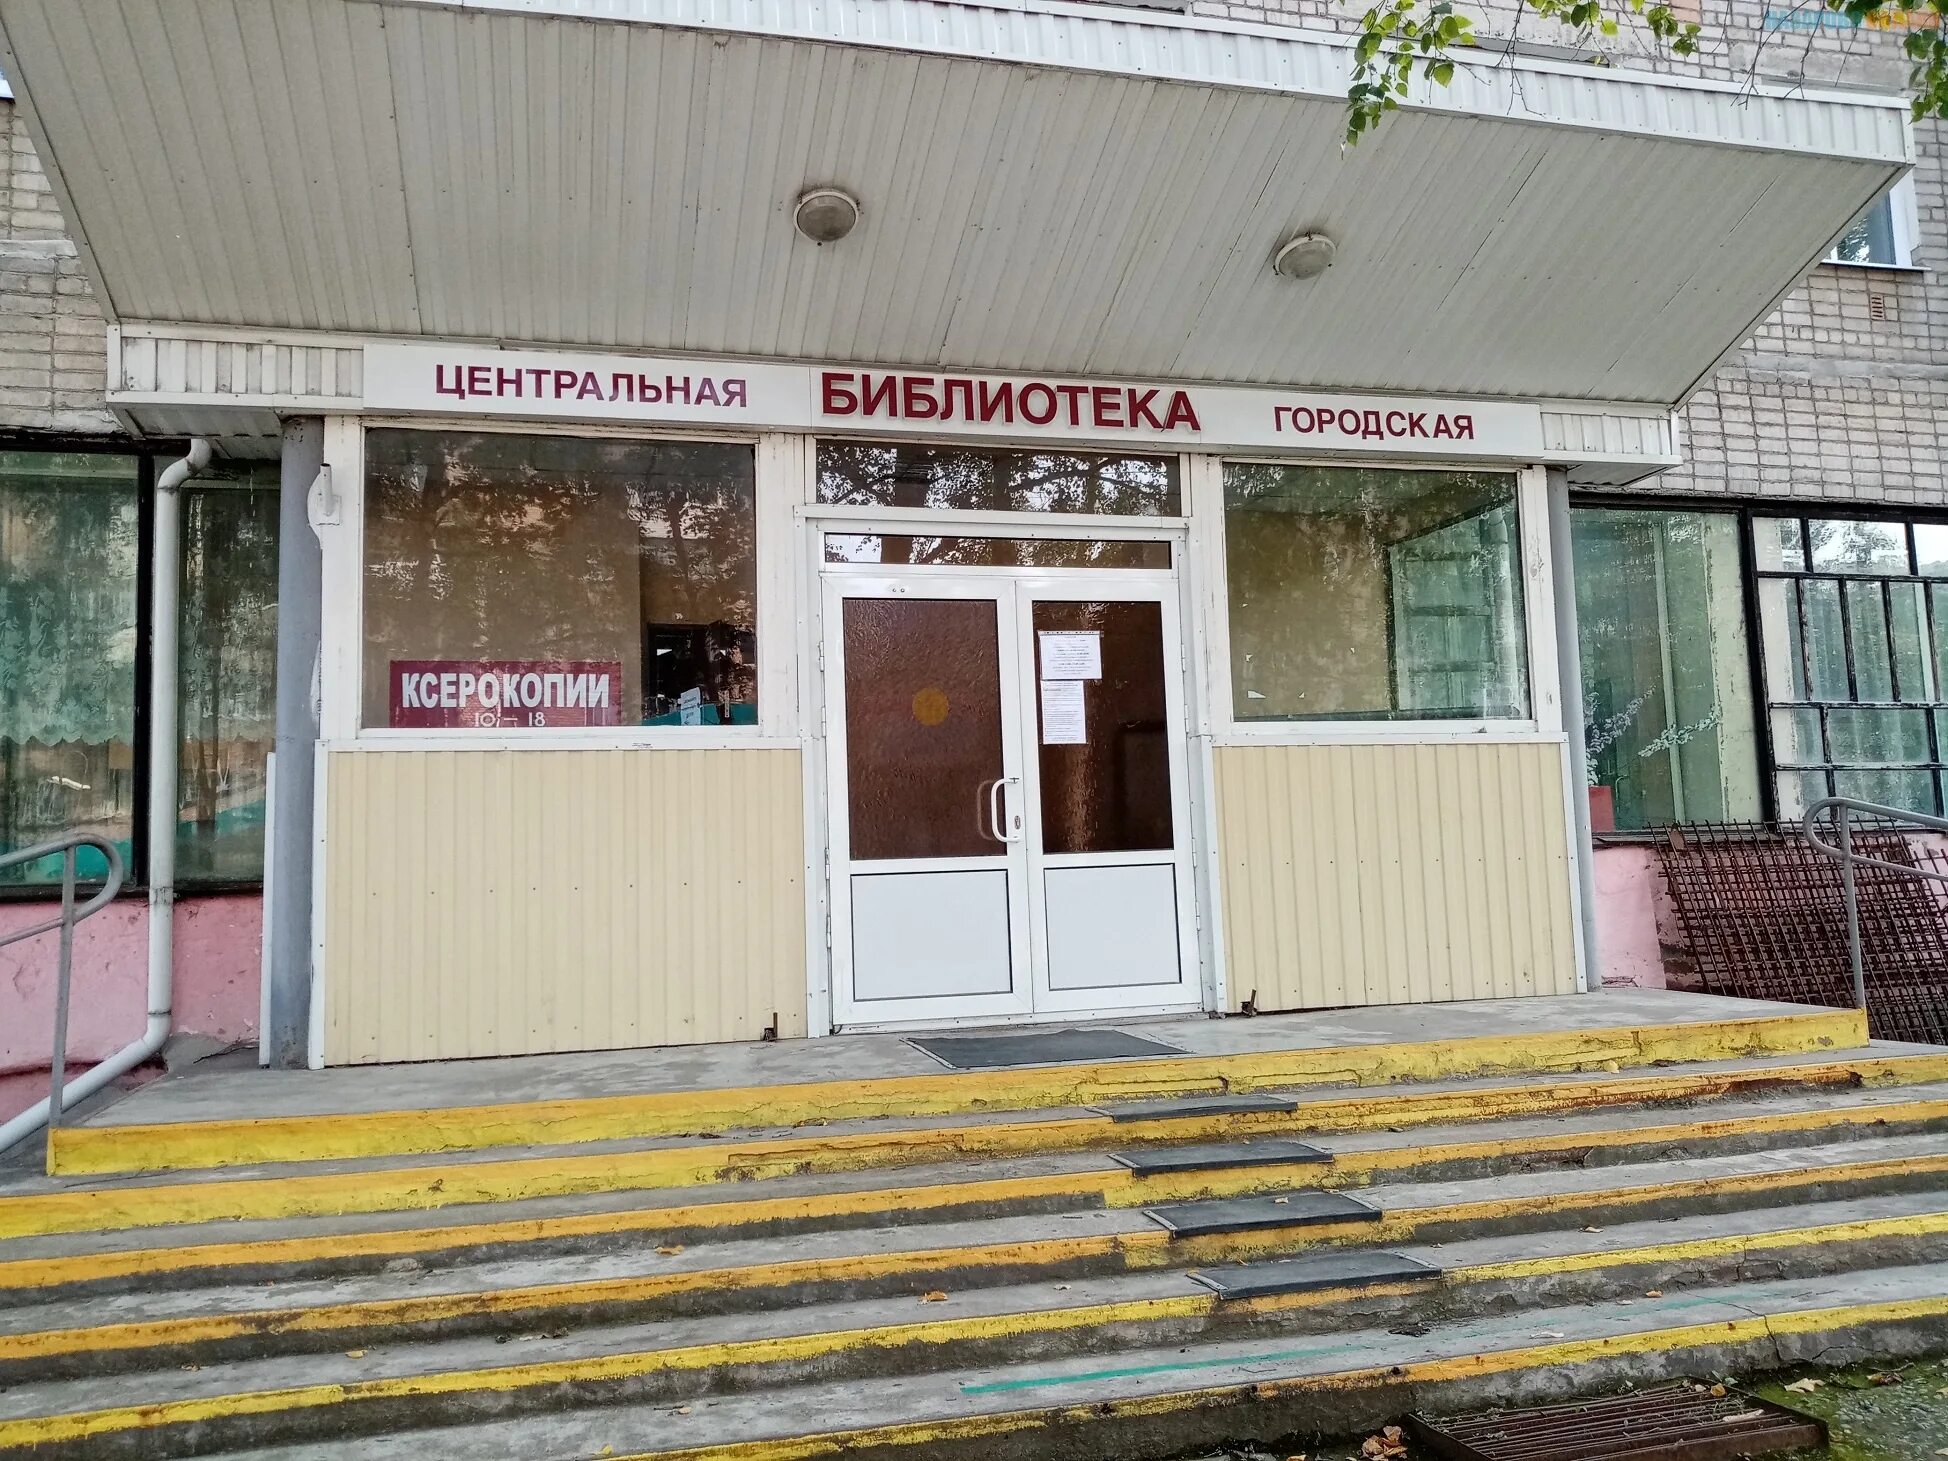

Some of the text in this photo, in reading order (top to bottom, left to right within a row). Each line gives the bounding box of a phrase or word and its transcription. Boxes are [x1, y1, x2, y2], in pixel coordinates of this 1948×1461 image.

[435, 364, 1476, 441] ЦЕНТРАЛЬНАЯ БИБЛИОТЕКА ГОРОДСКАЯ
[401, 672, 610, 709] КСЕРОКОПИИ
[528, 711, 546, 727] 18
